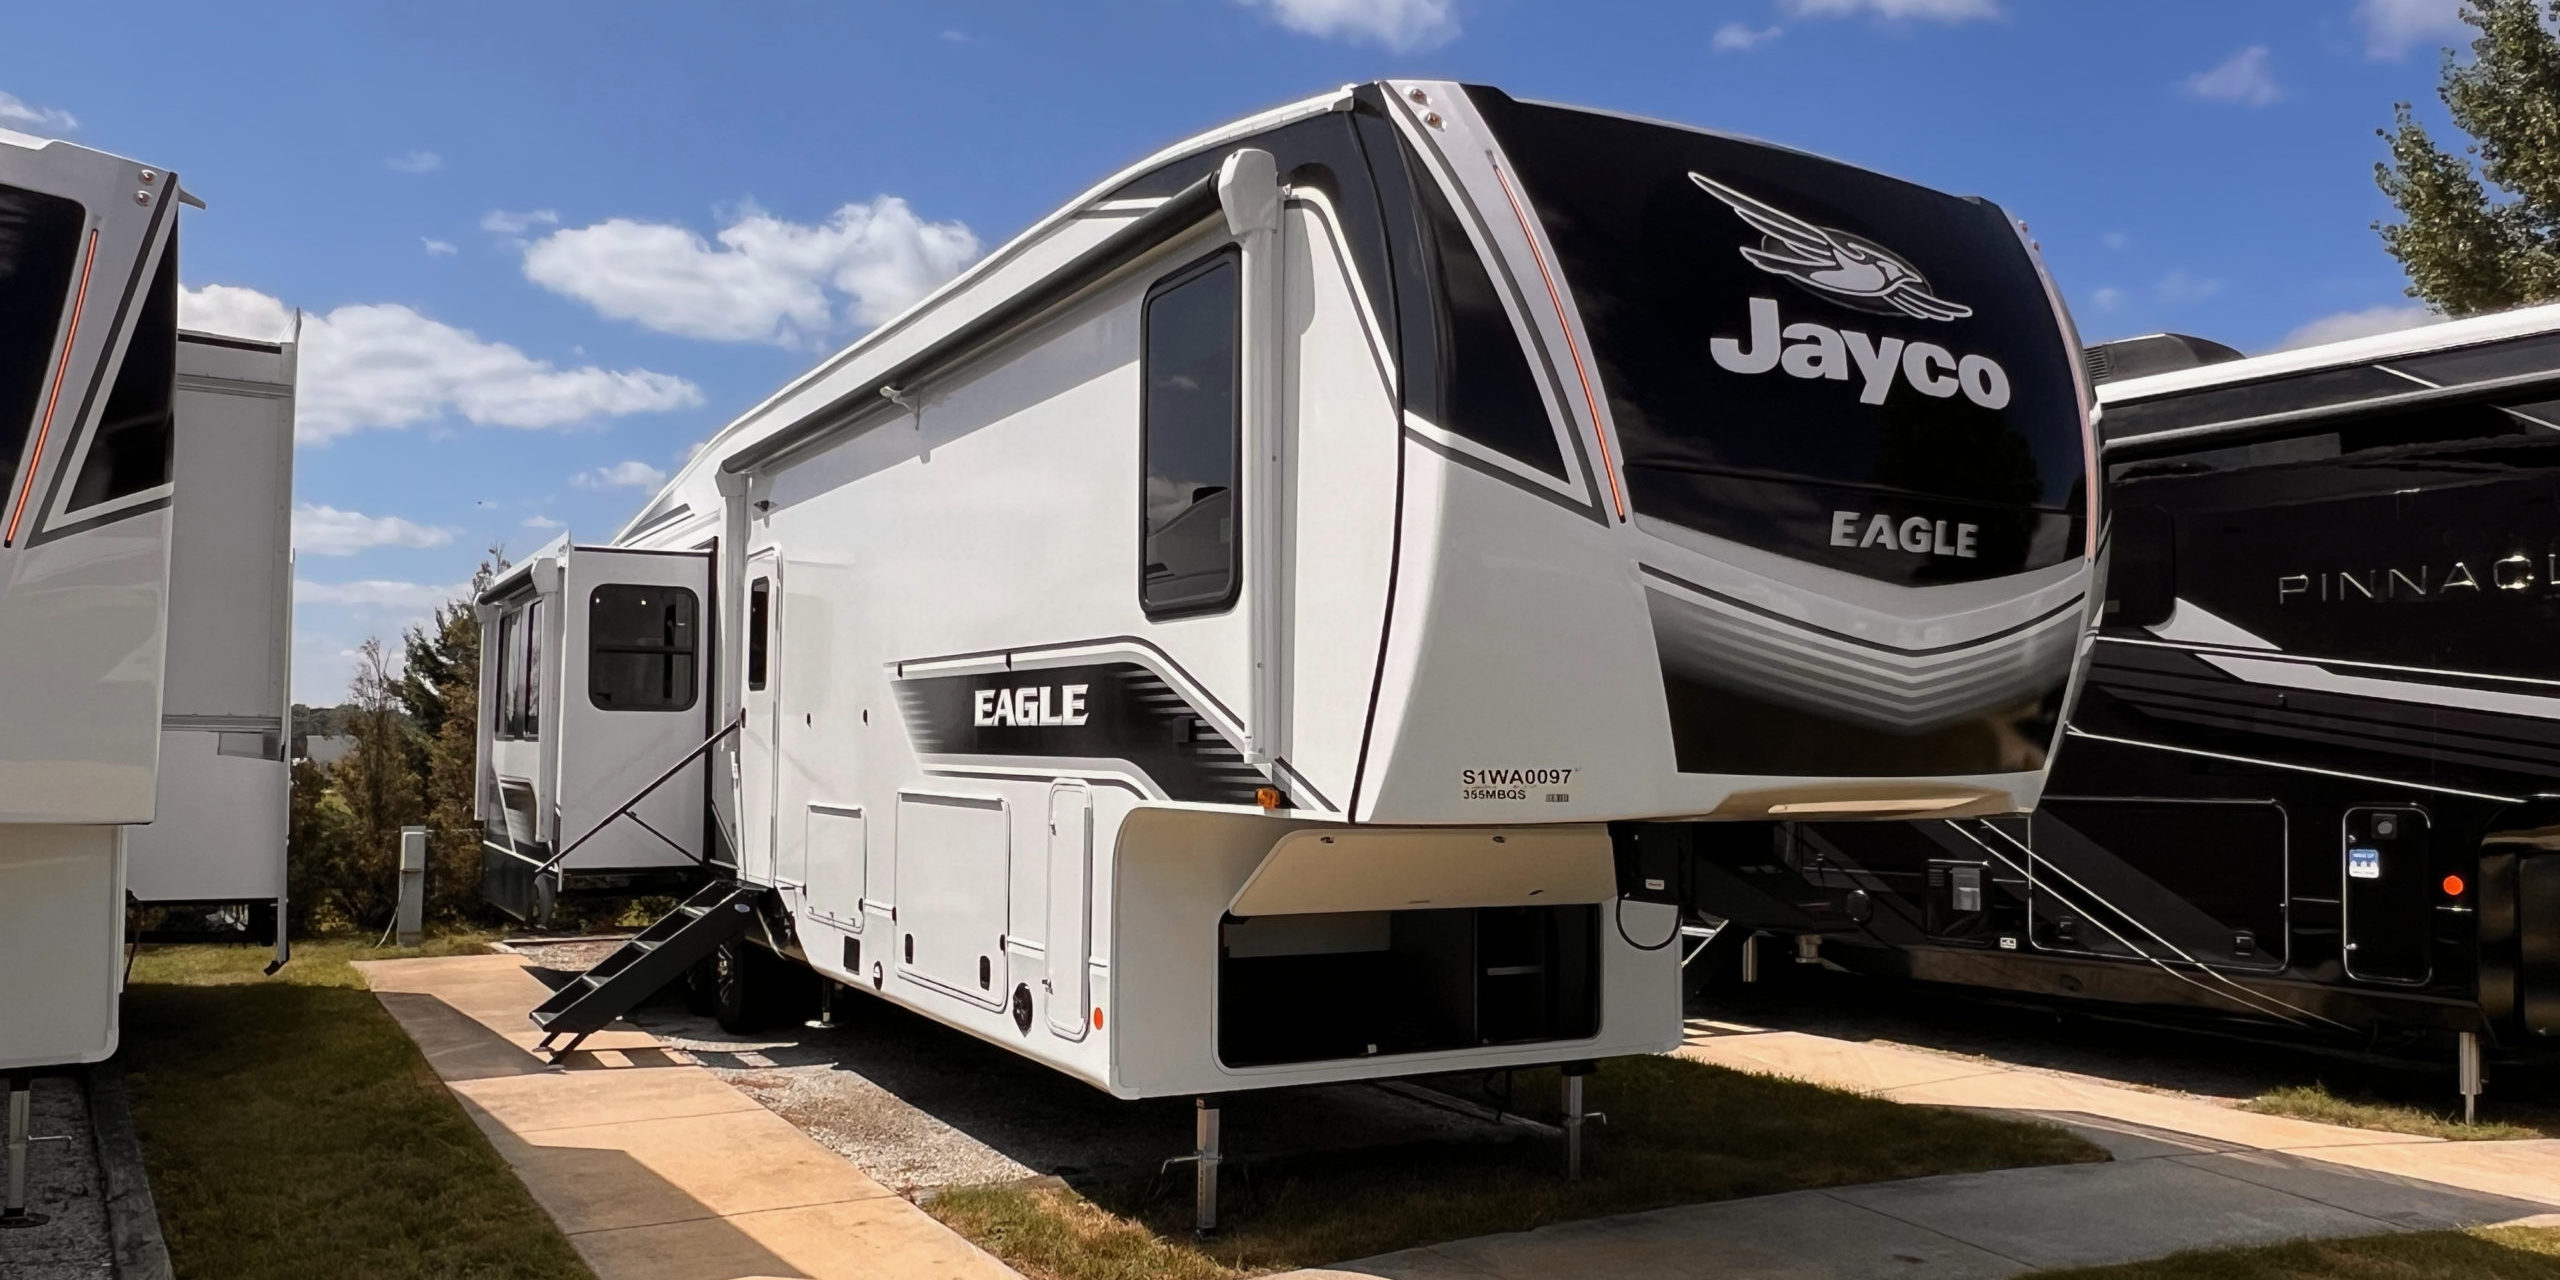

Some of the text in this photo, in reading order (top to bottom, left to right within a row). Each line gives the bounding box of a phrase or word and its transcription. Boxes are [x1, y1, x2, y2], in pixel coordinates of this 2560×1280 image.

[1710, 297, 2010, 410] Jayco
[1830, 510, 1979, 558] EAGLE
[974, 684, 1089, 727] EAGLE
[1463, 769, 1572, 785] S1WA0097
[1463, 789, 1526, 800] 355MBQS
